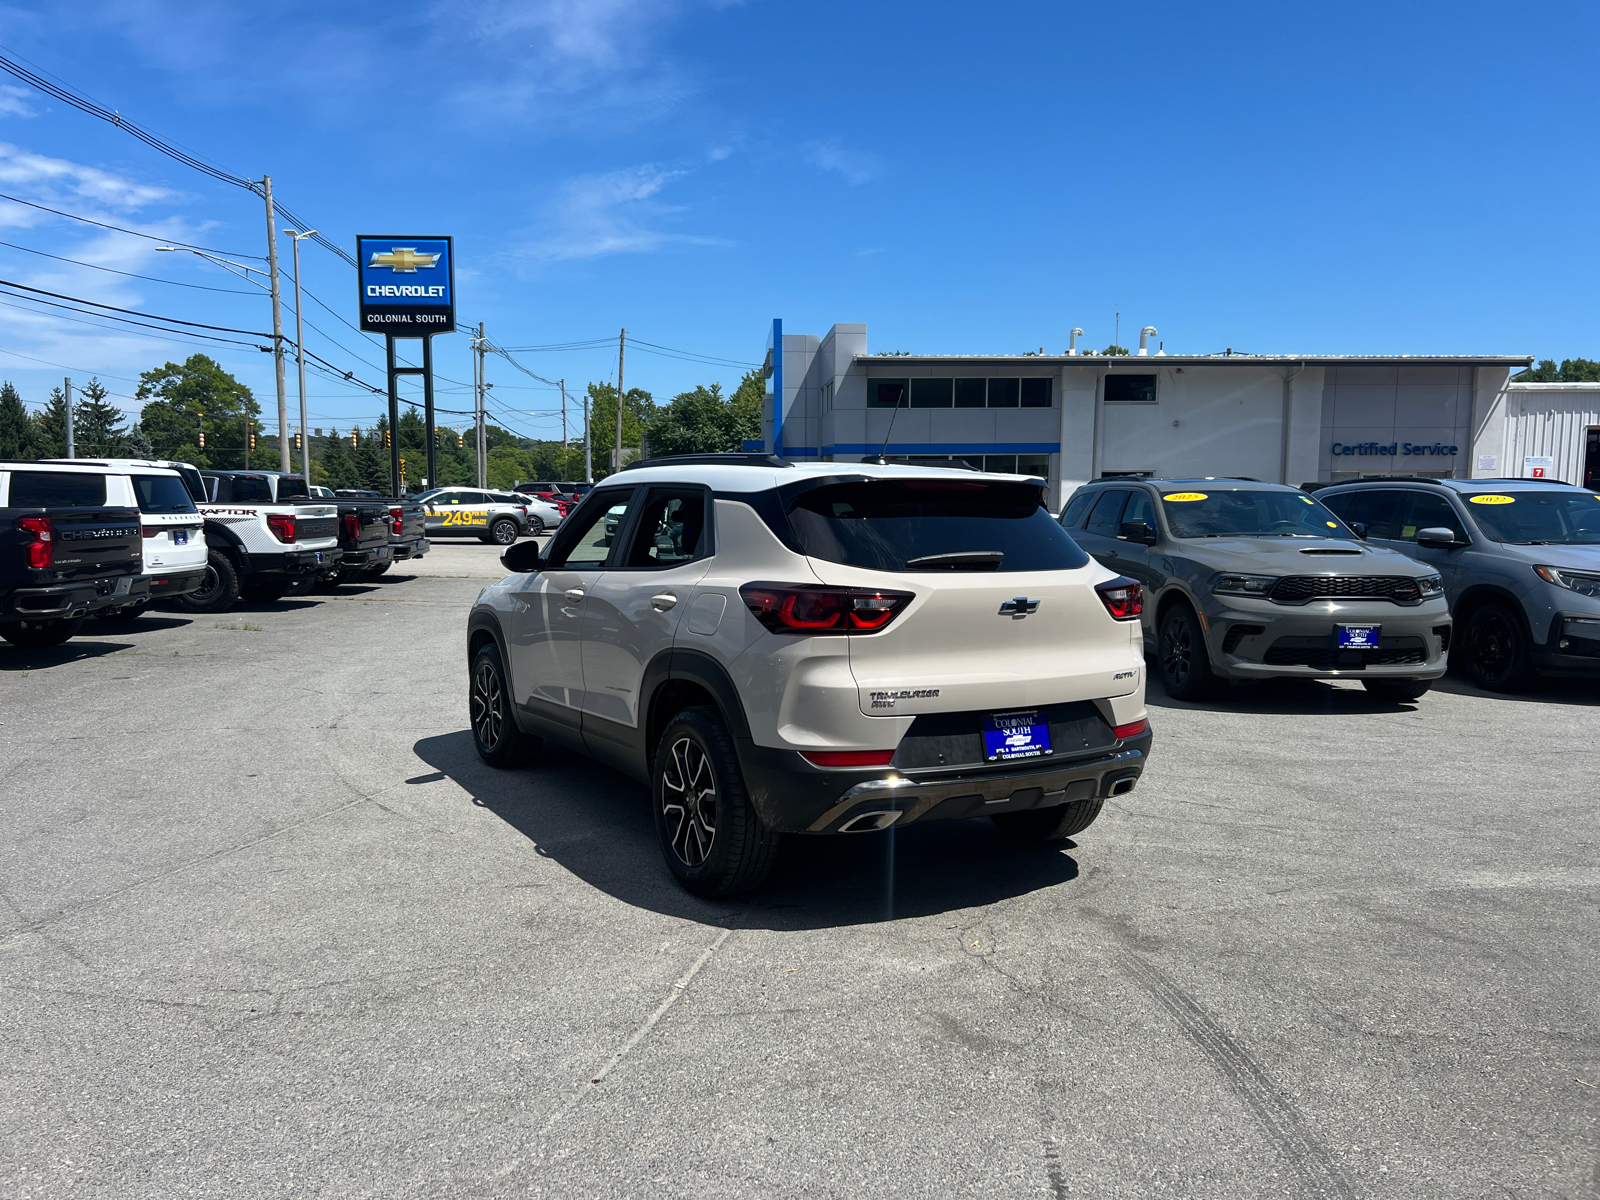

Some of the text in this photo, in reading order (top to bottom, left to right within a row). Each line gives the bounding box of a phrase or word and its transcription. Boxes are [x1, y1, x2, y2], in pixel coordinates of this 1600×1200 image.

[367, 285, 446, 297] CHEVROLET
[367, 314, 447, 323] COLONIAL SOUTH
[1332, 442, 1458, 456] Certified Service
[198, 508, 259, 518] RAPTOR
[62, 528, 139, 540] CHEVROLET
[302, 524, 335, 533] FORD
[1112, 670, 1137, 681] ACTIV
[869, 689, 940, 701] TRAILBLAZER
[871, 700, 895, 709] AWD
[995, 717, 1035, 728] COLONIAL
[1003, 726, 1031, 736] SOUTH
